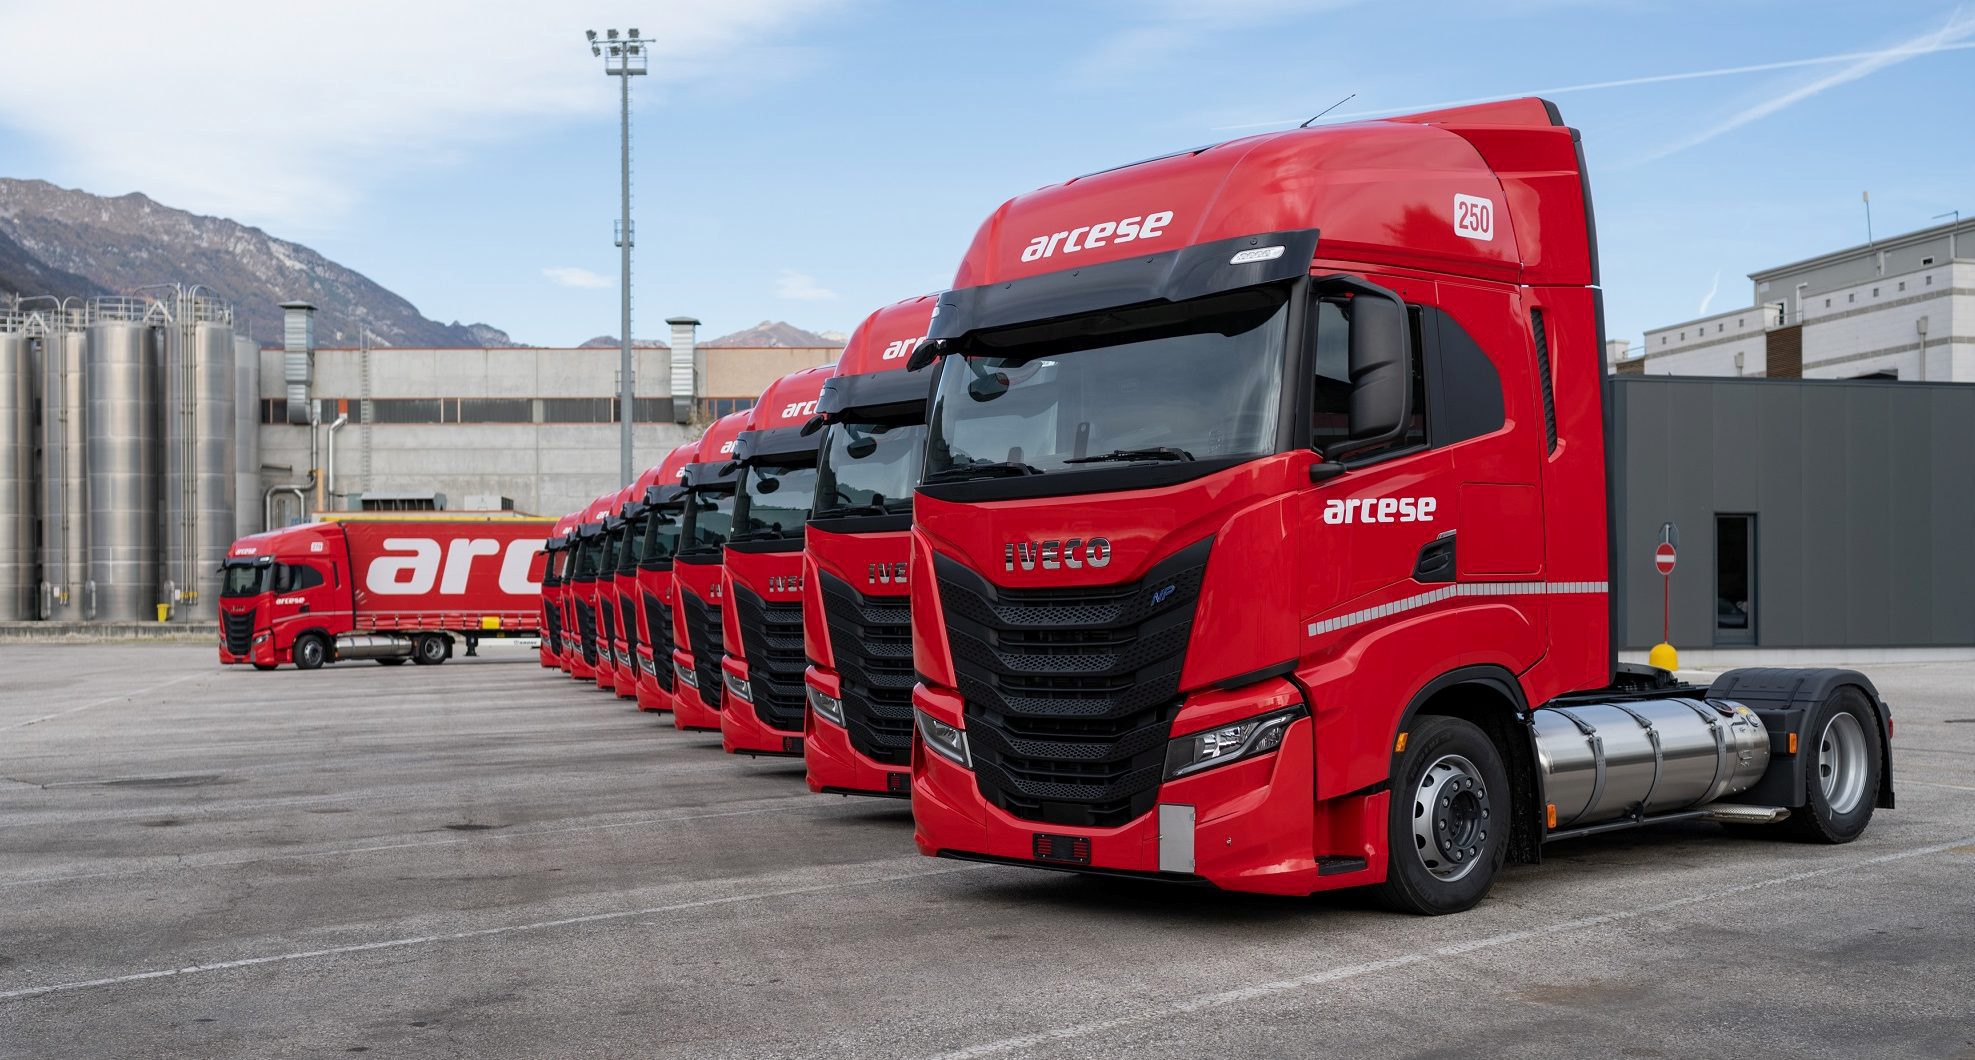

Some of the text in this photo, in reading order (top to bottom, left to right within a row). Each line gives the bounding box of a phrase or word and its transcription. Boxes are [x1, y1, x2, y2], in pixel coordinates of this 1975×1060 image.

[1458, 201, 1490, 234] 250
[1021, 210, 1174, 262] arcese
[781, 400, 818, 418] arc
[1323, 496, 1437, 524] arcese
[1005, 537, 1111, 572] IVECO
